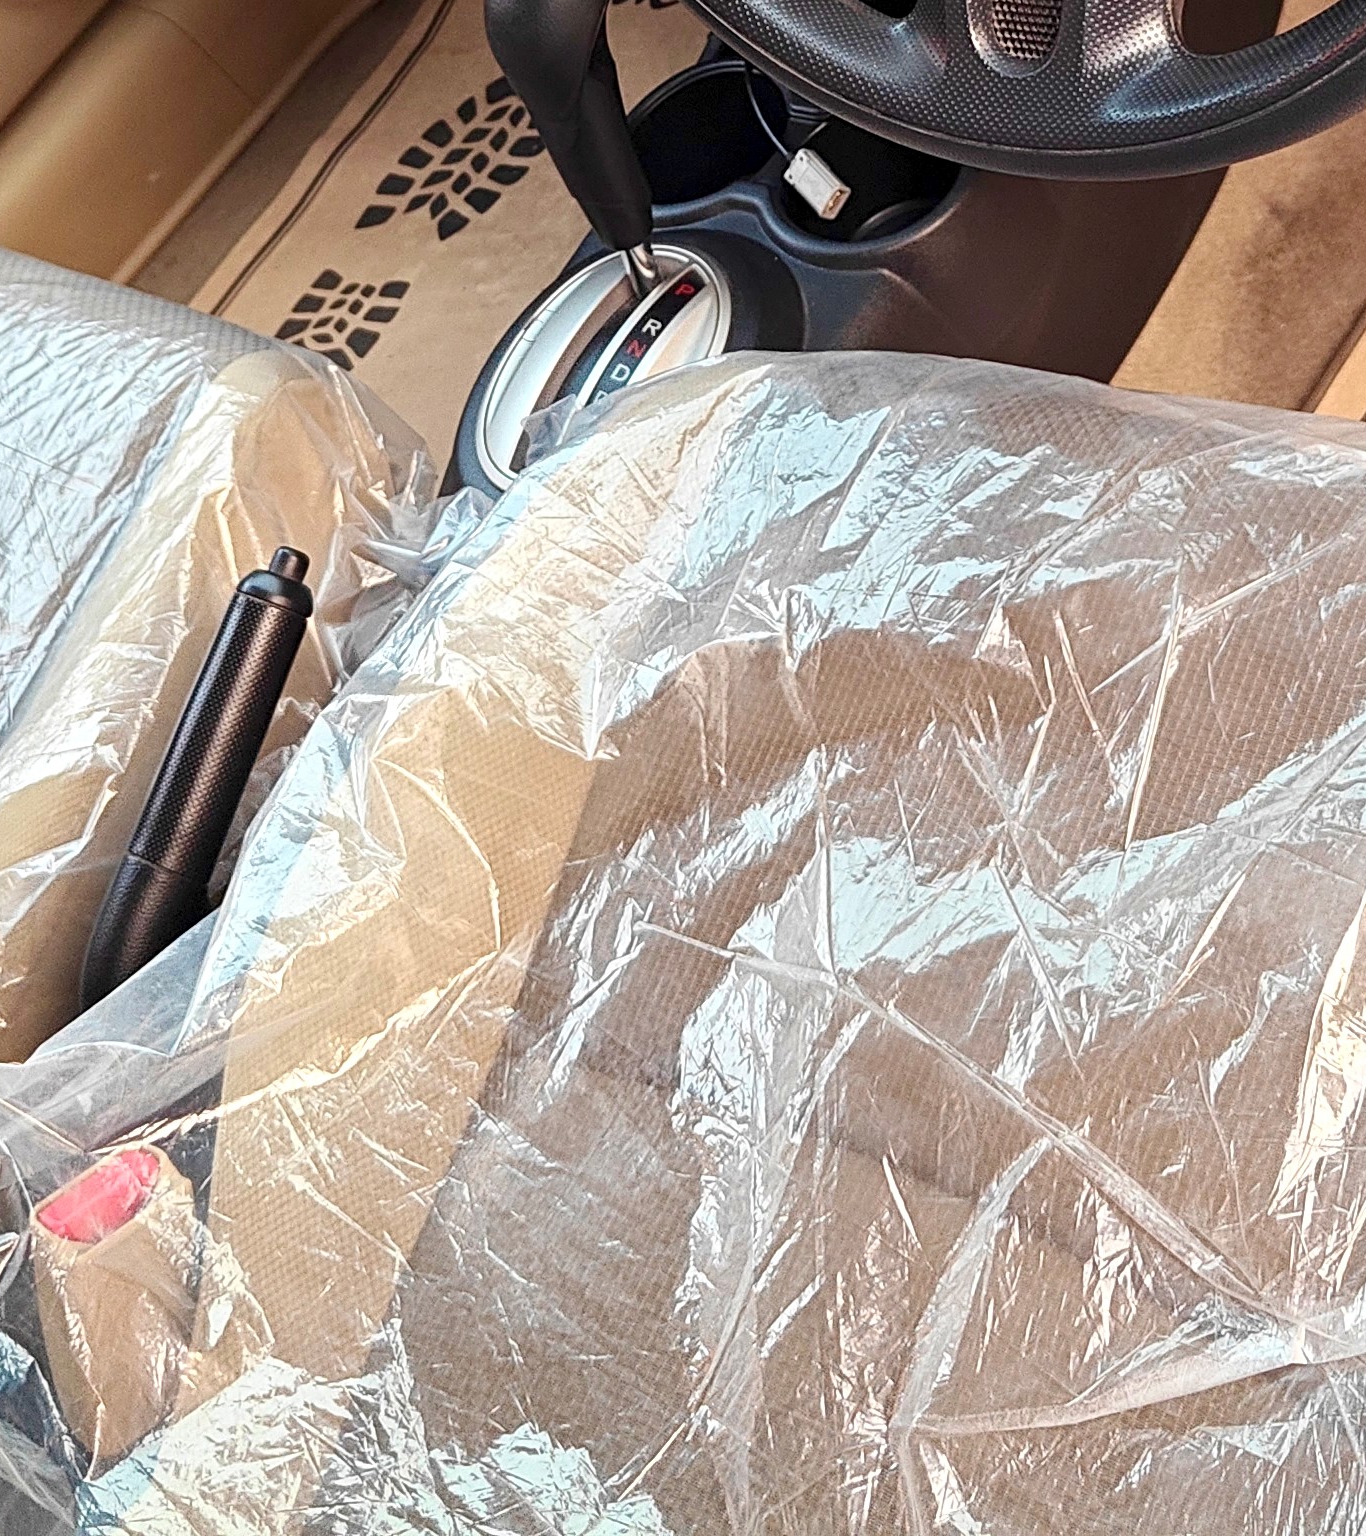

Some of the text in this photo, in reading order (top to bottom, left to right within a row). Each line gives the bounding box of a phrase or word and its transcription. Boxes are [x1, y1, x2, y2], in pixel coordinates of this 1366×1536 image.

[675, 283, 695, 295] P
[641, 318, 663, 337] R
[626, 339, 647, 359] N
[610, 363, 631, 382] D
